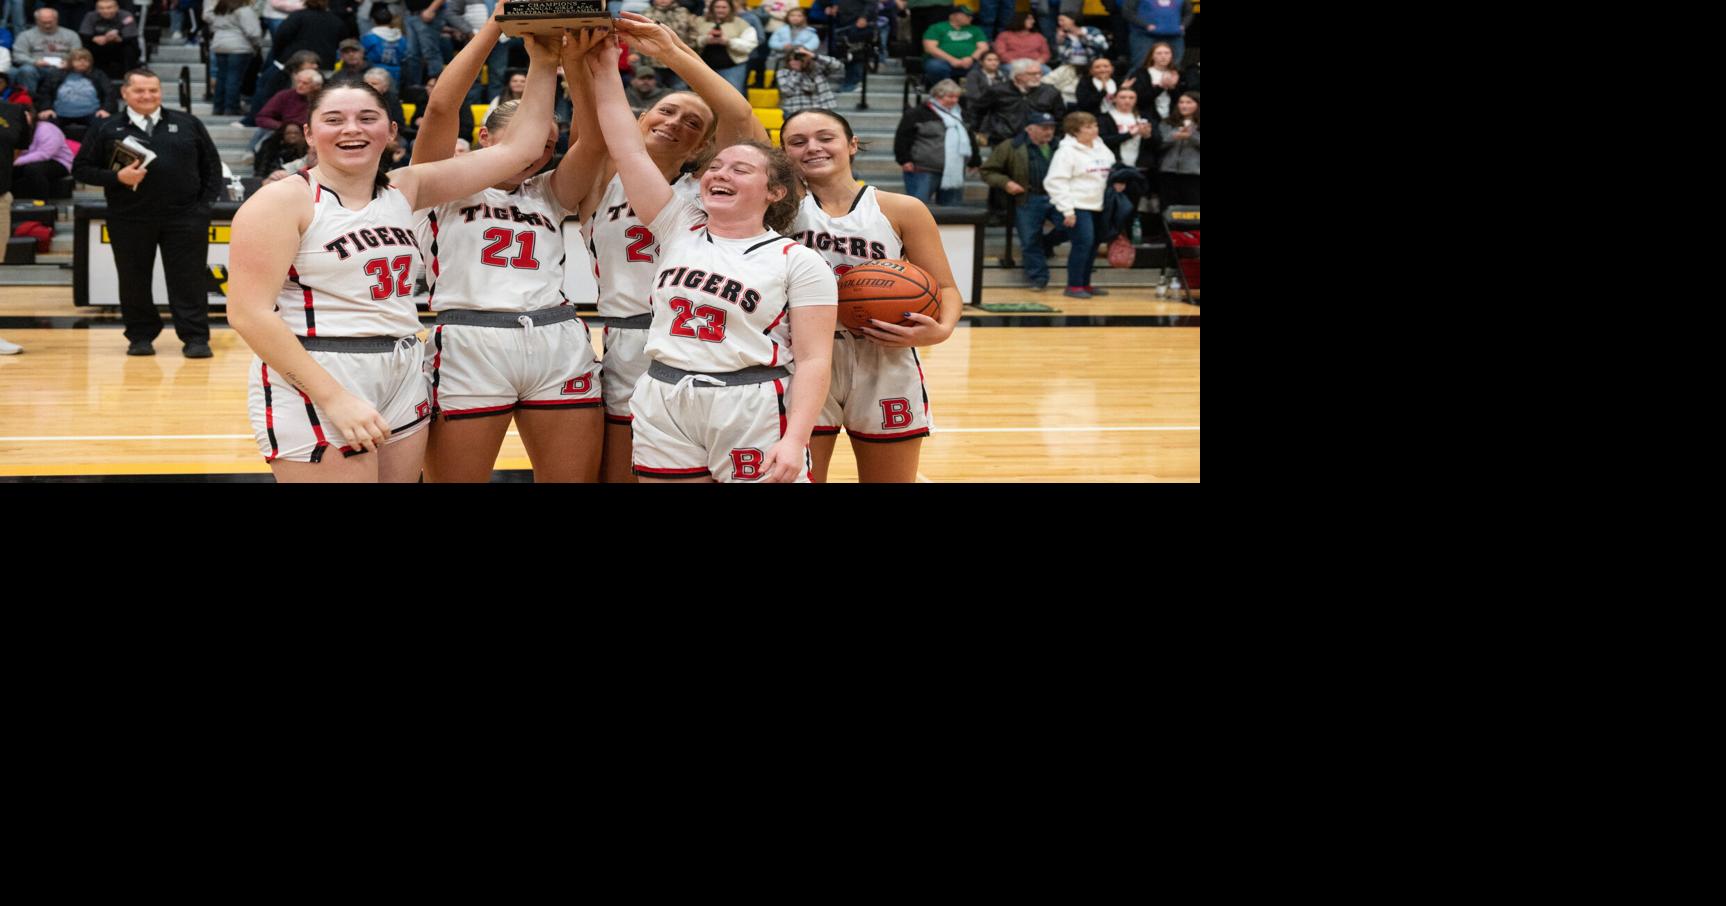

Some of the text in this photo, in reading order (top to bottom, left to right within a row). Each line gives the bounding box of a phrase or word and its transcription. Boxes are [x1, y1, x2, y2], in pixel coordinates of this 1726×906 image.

[459, 201, 556, 233] TIGERS
[323, 226, 420, 260] TIGERS
[481, 227, 540, 270] 21
[625, 224, 661, 263] 2
[364, 254, 413, 301] 32
[656, 266, 762, 315] TIGERS
[668, 296, 728, 343] 23
[879, 397, 913, 430] B
[730, 447, 766, 480] B
